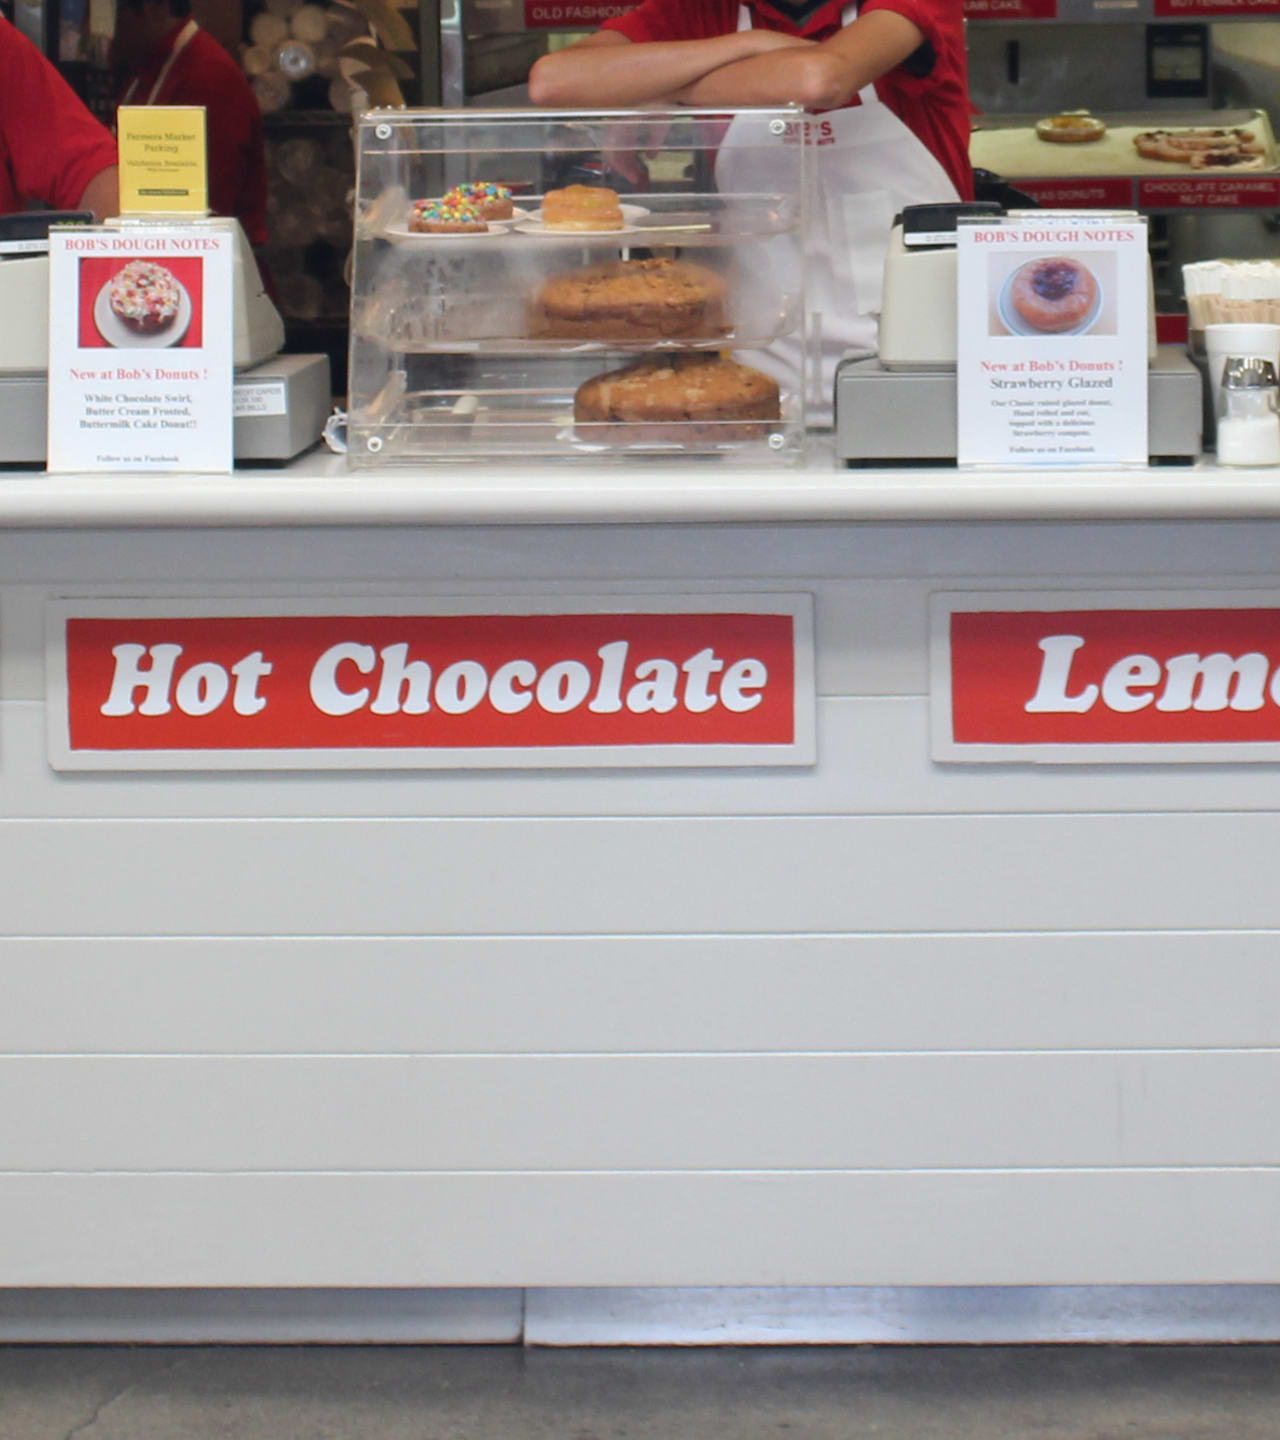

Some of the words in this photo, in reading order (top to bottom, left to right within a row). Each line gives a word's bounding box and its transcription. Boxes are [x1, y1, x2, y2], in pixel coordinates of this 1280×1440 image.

[532, 7, 562, 19] OLD
[1144, 182, 1217, 193] CHOCOLATE
[1219, 181, 1276, 192] CARAMEL
[974, 231, 1019, 243] BOB'S
[1023, 231, 1080, 243] DOUGH
[1083, 230, 1135, 242] NOTES
[65, 239, 109, 250] BOB'S
[112, 239, 167, 250] DOUGH
[170, 238, 220, 250] NOTES
[980, 361, 1008, 372] New
[1012, 362, 1024, 372] at
[1029, 360, 1065, 372] Bob's
[1069, 360, 1115, 372] Donuts
[70, 368, 96, 380] New
[101, 370, 112, 380] at
[116, 368, 152, 380] Bob's
[155, 368, 199, 380] Donuts
[990, 377, 1063, 391] Strawberry
[1067, 376, 1113, 389] Glazed
[84, 393, 112, 403] White
[115, 393, 161, 403] Chocolate
[118, 407, 150, 416] Cream
[80, 419, 131, 429] Buttermilk
[133, 419, 157, 429] Cake
[100, 642, 273, 716] Hot
[309, 640, 769, 716] Chocolate
